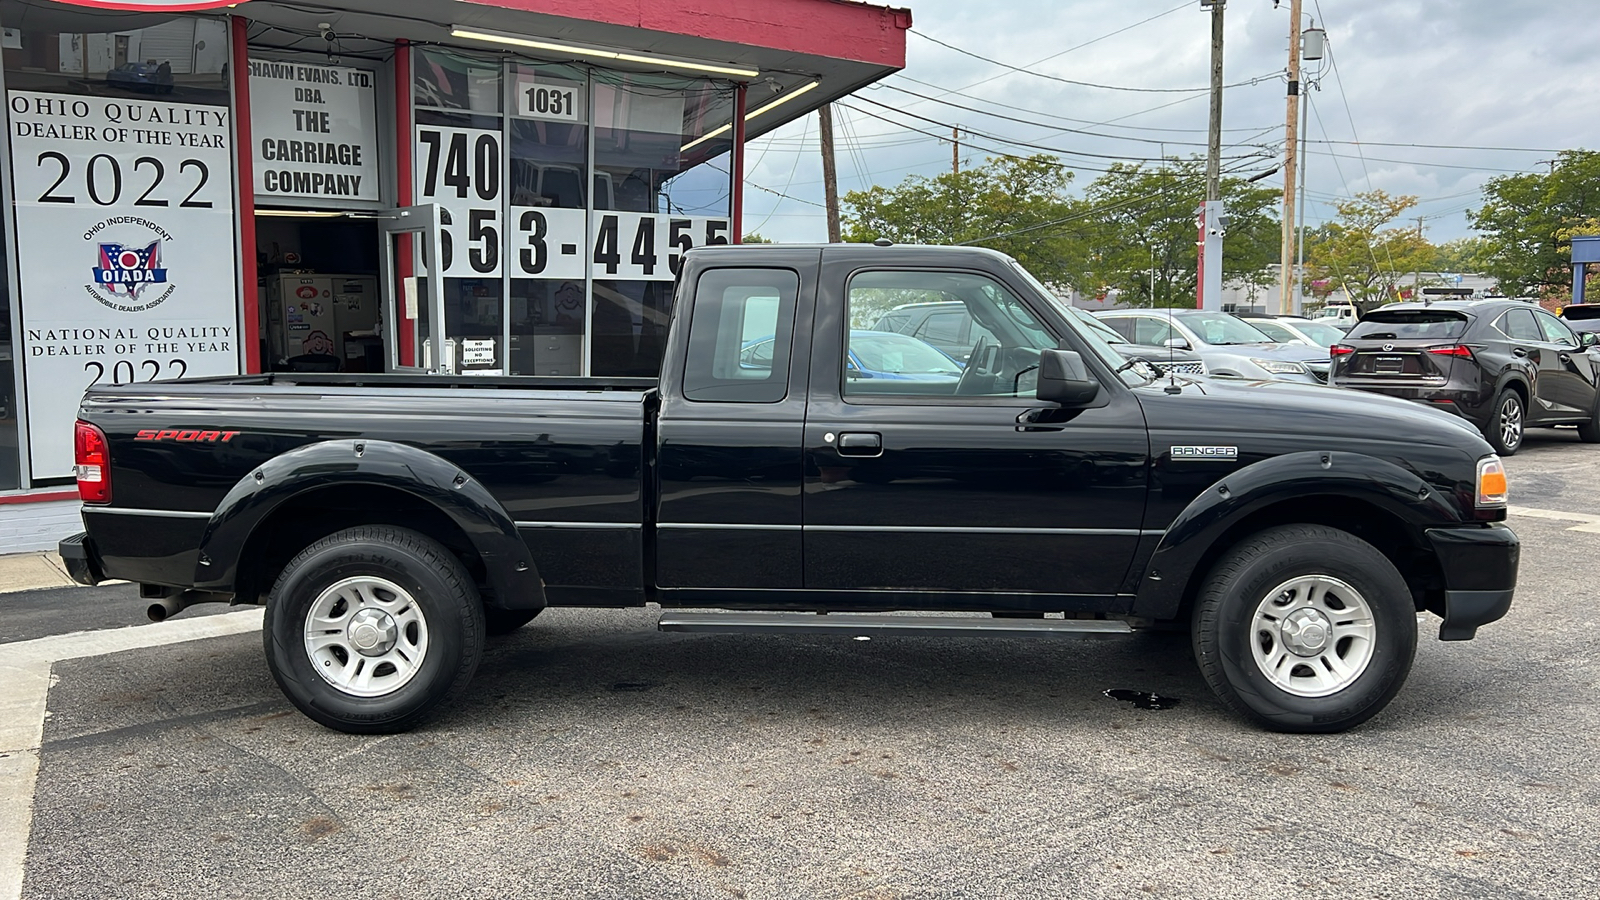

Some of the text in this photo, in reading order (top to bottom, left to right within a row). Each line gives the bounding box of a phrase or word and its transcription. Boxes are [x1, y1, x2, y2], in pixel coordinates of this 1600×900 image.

[297, 66, 343, 85] EVANS.
[347, 72, 373, 88] LTD.
[294, 87, 326, 104] DBA.
[525, 87, 573, 115] 1031
[11, 96, 227, 127] OHIO QUALITY
[292, 109, 331, 134] THE
[15, 121, 226, 149] DEALER OF THE YEAR
[261, 138, 362, 166] CARRIAGE
[419, 130, 499, 200] 740
[37, 151, 213, 208] 2022
[264, 169, 362, 196] COMPANY
[83, 216, 174, 242] OHIO INDEPENDENT
[102, 269, 155, 282] OIADA
[84, 283, 176, 312] AUTOMOBILE DEALERS ASSOCIATION
[28, 326, 232, 341] NATIONAL QUALITY
[32, 341, 231, 357] DEALER OF THE YEAR
[84, 358, 188, 391] 2022
[134, 429, 241, 442] SPORT
[1172, 446, 1236, 456] RANGER
